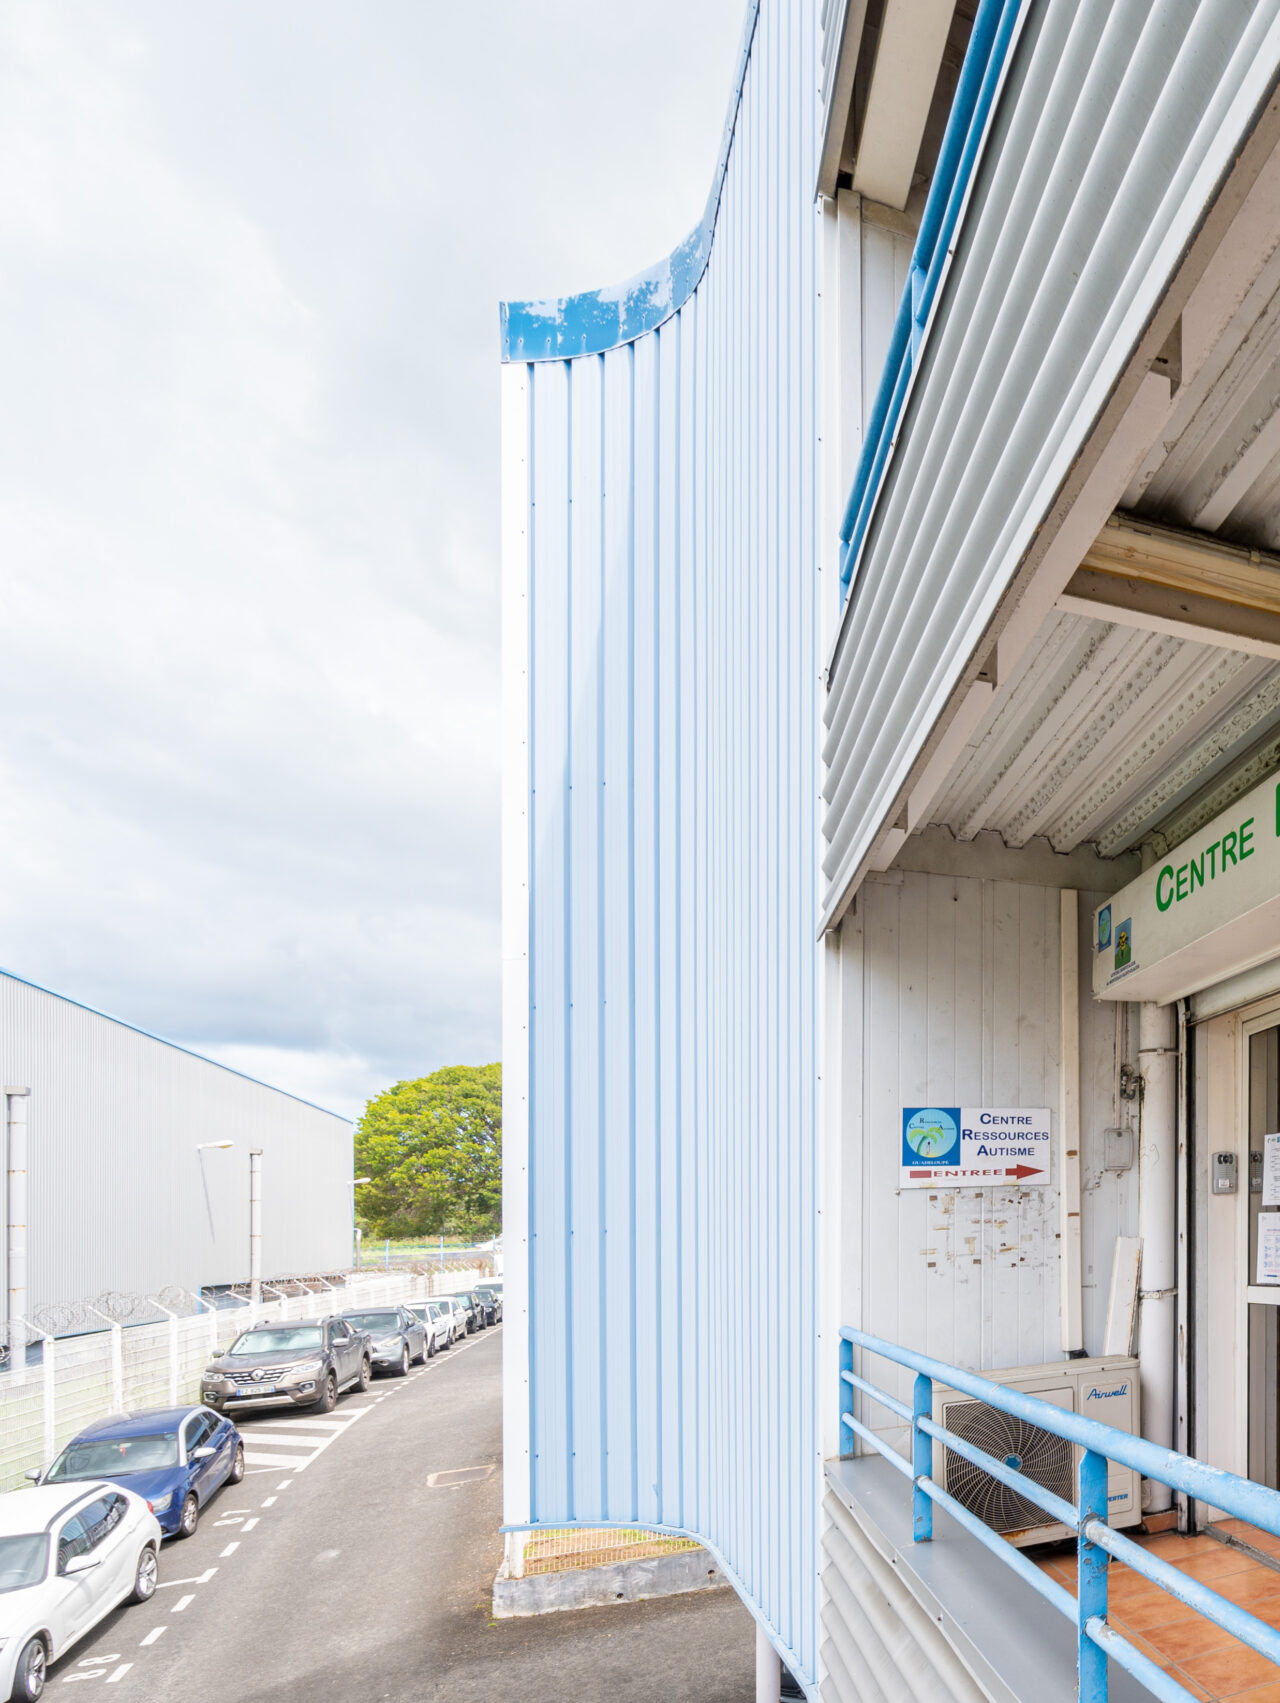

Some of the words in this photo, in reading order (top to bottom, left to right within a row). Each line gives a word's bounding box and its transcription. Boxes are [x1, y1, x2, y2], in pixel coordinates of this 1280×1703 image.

[1155, 817, 1255, 912] CENTRE
[980, 1113, 1032, 1125] CENTRE
[962, 1129, 1049, 1141] RESSOURCES
[976, 1145, 1035, 1157] AUTISME
[933, 1169, 1002, 1177] ENTREE
[1086, 1384, 1128, 1400] Airwell
